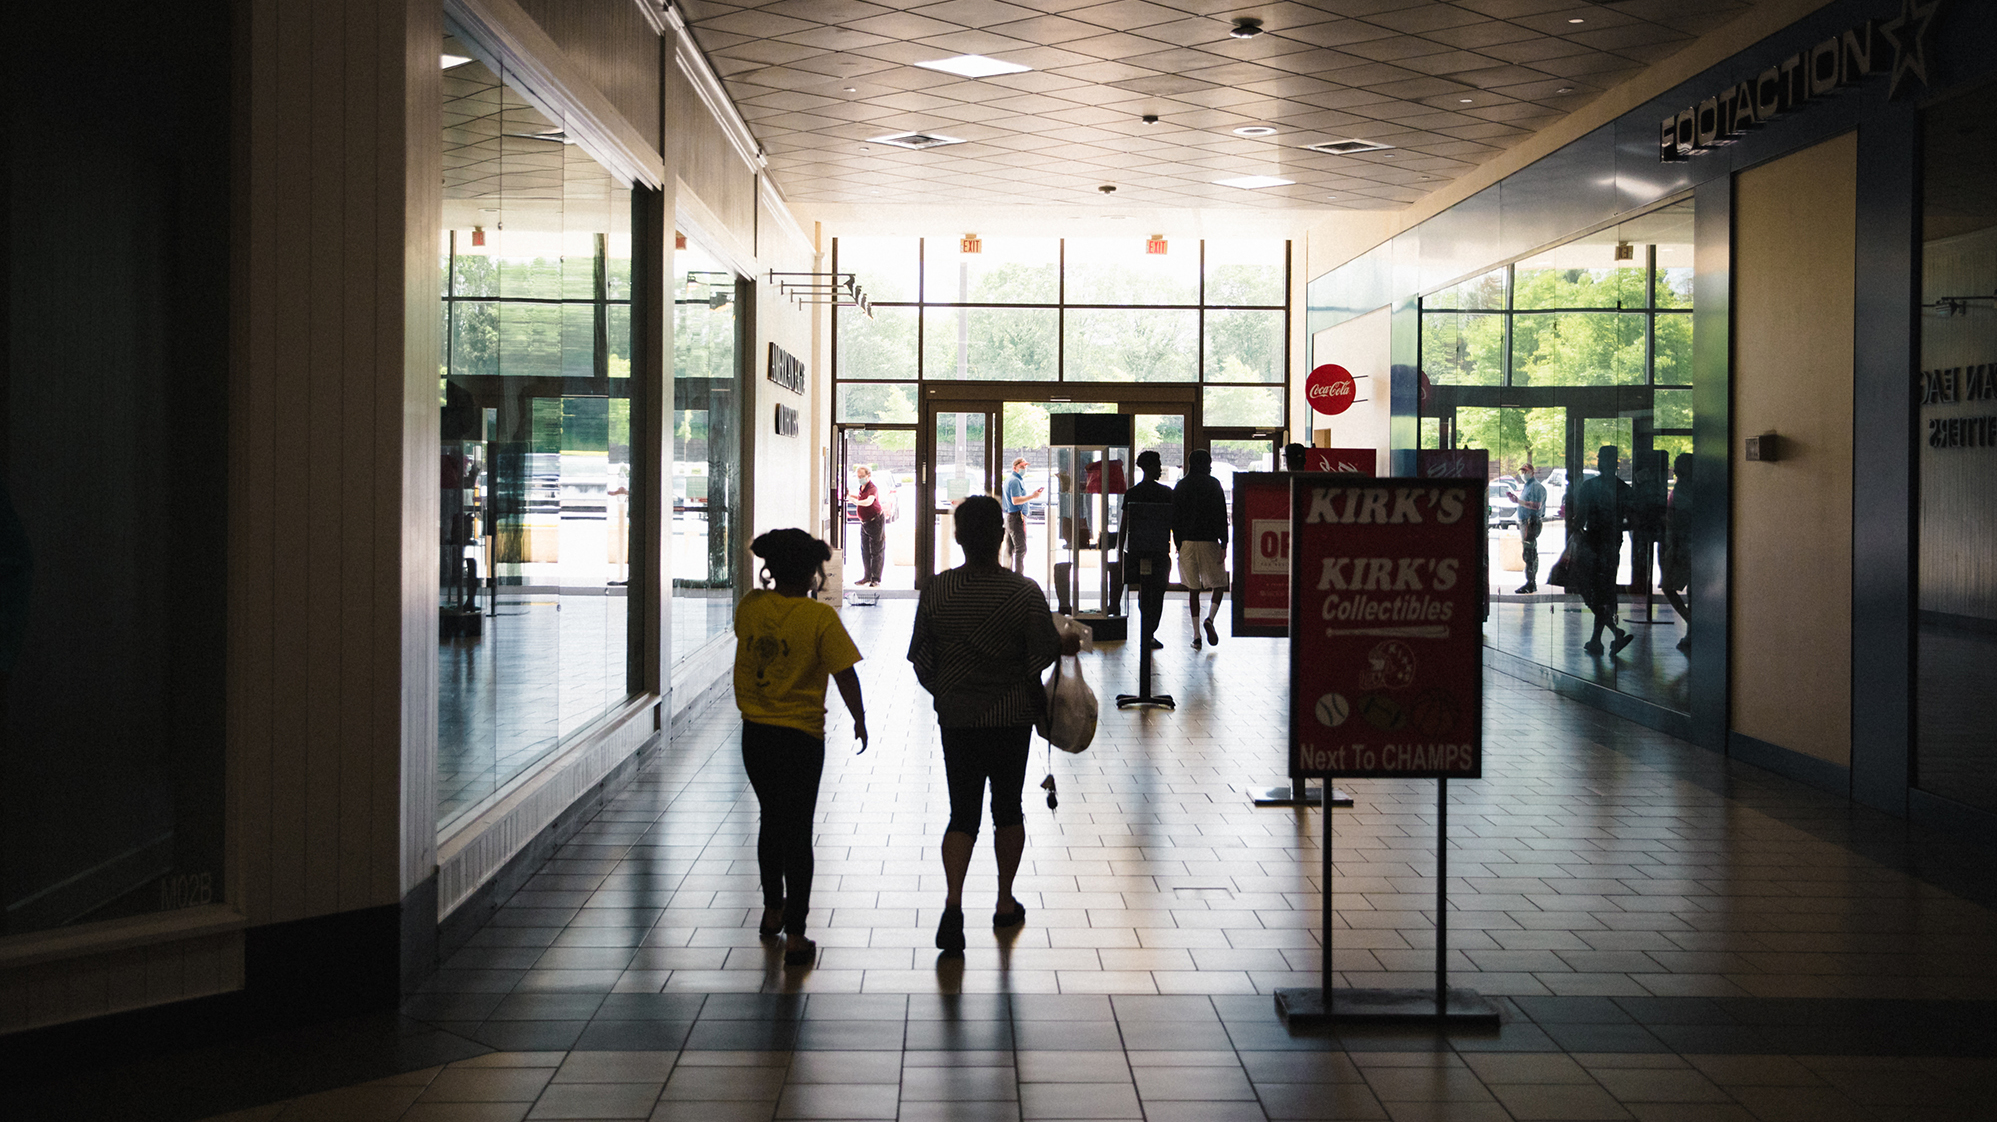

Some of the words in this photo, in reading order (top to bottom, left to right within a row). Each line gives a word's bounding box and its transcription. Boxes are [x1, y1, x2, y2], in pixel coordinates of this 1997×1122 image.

[1660, 19, 1871, 163] FOOTACTION
[963, 240, 980, 253] EXIT
[1148, 240, 1166, 254] EXIT
[1309, 380, 1352, 399] Coca-Cola
[1306, 488, 1466, 525] KIRK'S
[1317, 557, 1460, 592] KIRK'S
[1322, 593, 1454, 621] Collectibles
[1300, 743, 1345, 770] Next
[1352, 743, 1375, 770] To
[1382, 743, 1473, 770] CHAMPS
